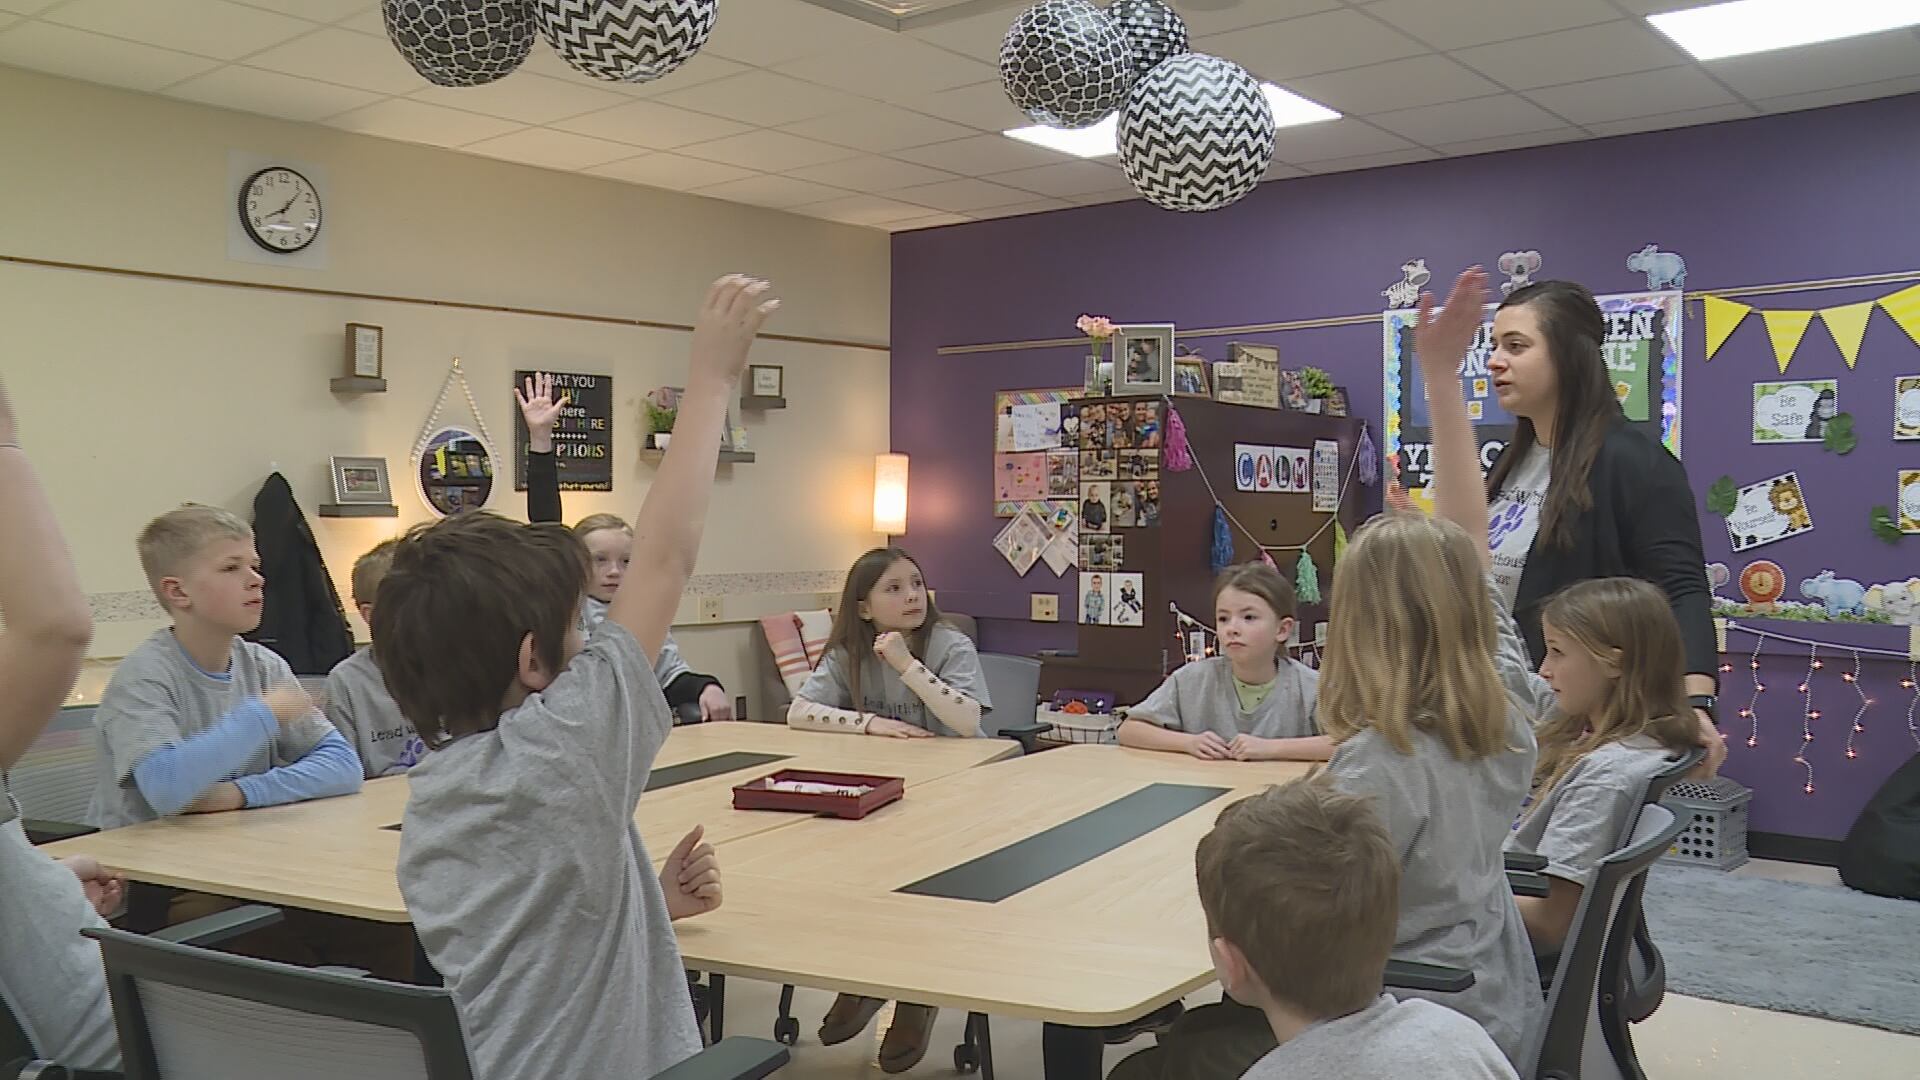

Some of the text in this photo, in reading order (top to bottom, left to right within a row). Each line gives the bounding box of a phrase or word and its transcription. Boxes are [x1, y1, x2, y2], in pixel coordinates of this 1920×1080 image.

[278, 172, 290, 184] 12
[253, 185, 264, 196] 10
[304, 192, 313, 204] 2
[309, 208, 316, 220] 3
[572, 377, 596, 389] YOU
[1779, 395, 1796, 408] Be
[1771, 412, 1804, 427] Safe
[1237, 452, 1308, 489] CALM
